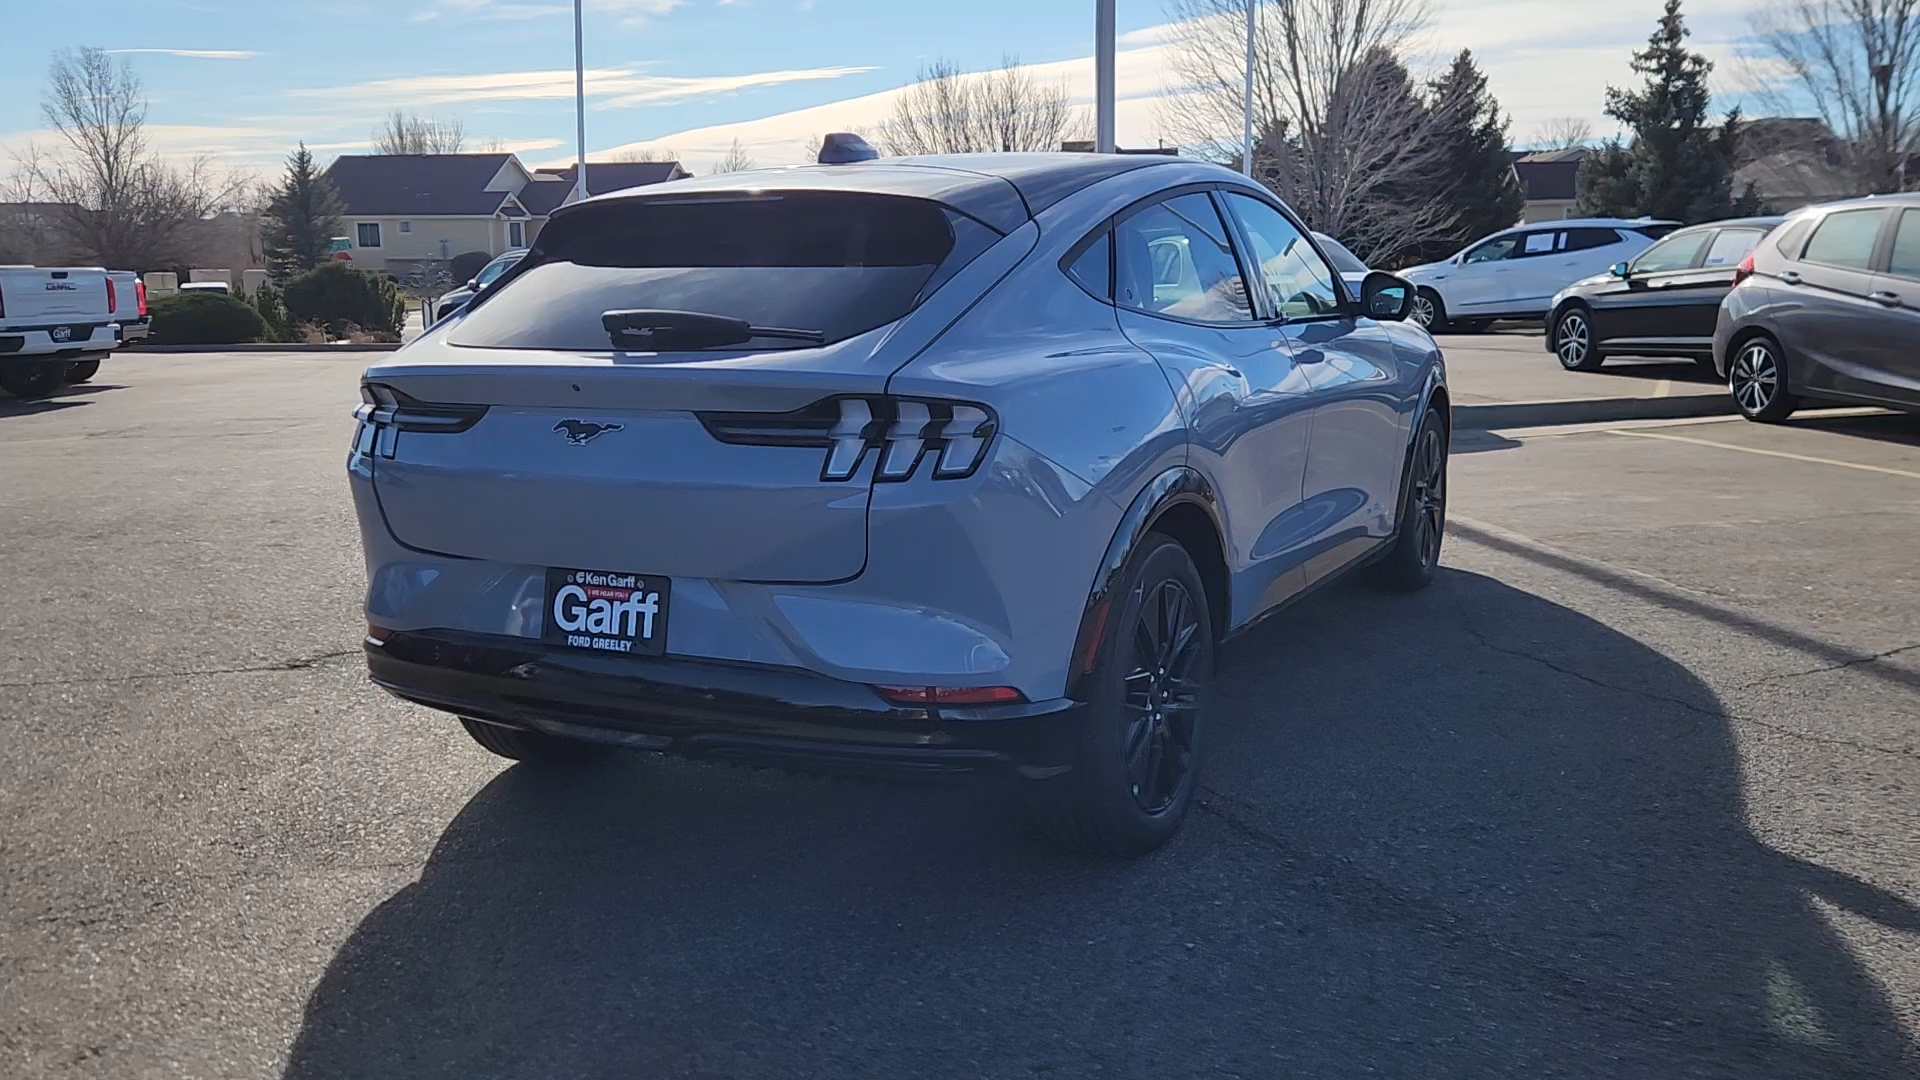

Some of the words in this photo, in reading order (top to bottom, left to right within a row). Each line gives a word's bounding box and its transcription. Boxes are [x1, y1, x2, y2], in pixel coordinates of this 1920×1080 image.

[585, 572, 606, 585] Ken
[608, 574, 635, 588] Garff
[591, 589, 600, 597] WE
[554, 585, 658, 638] Garff
[568, 635, 590, 647] FORD
[593, 638, 632, 652] GREELEY
